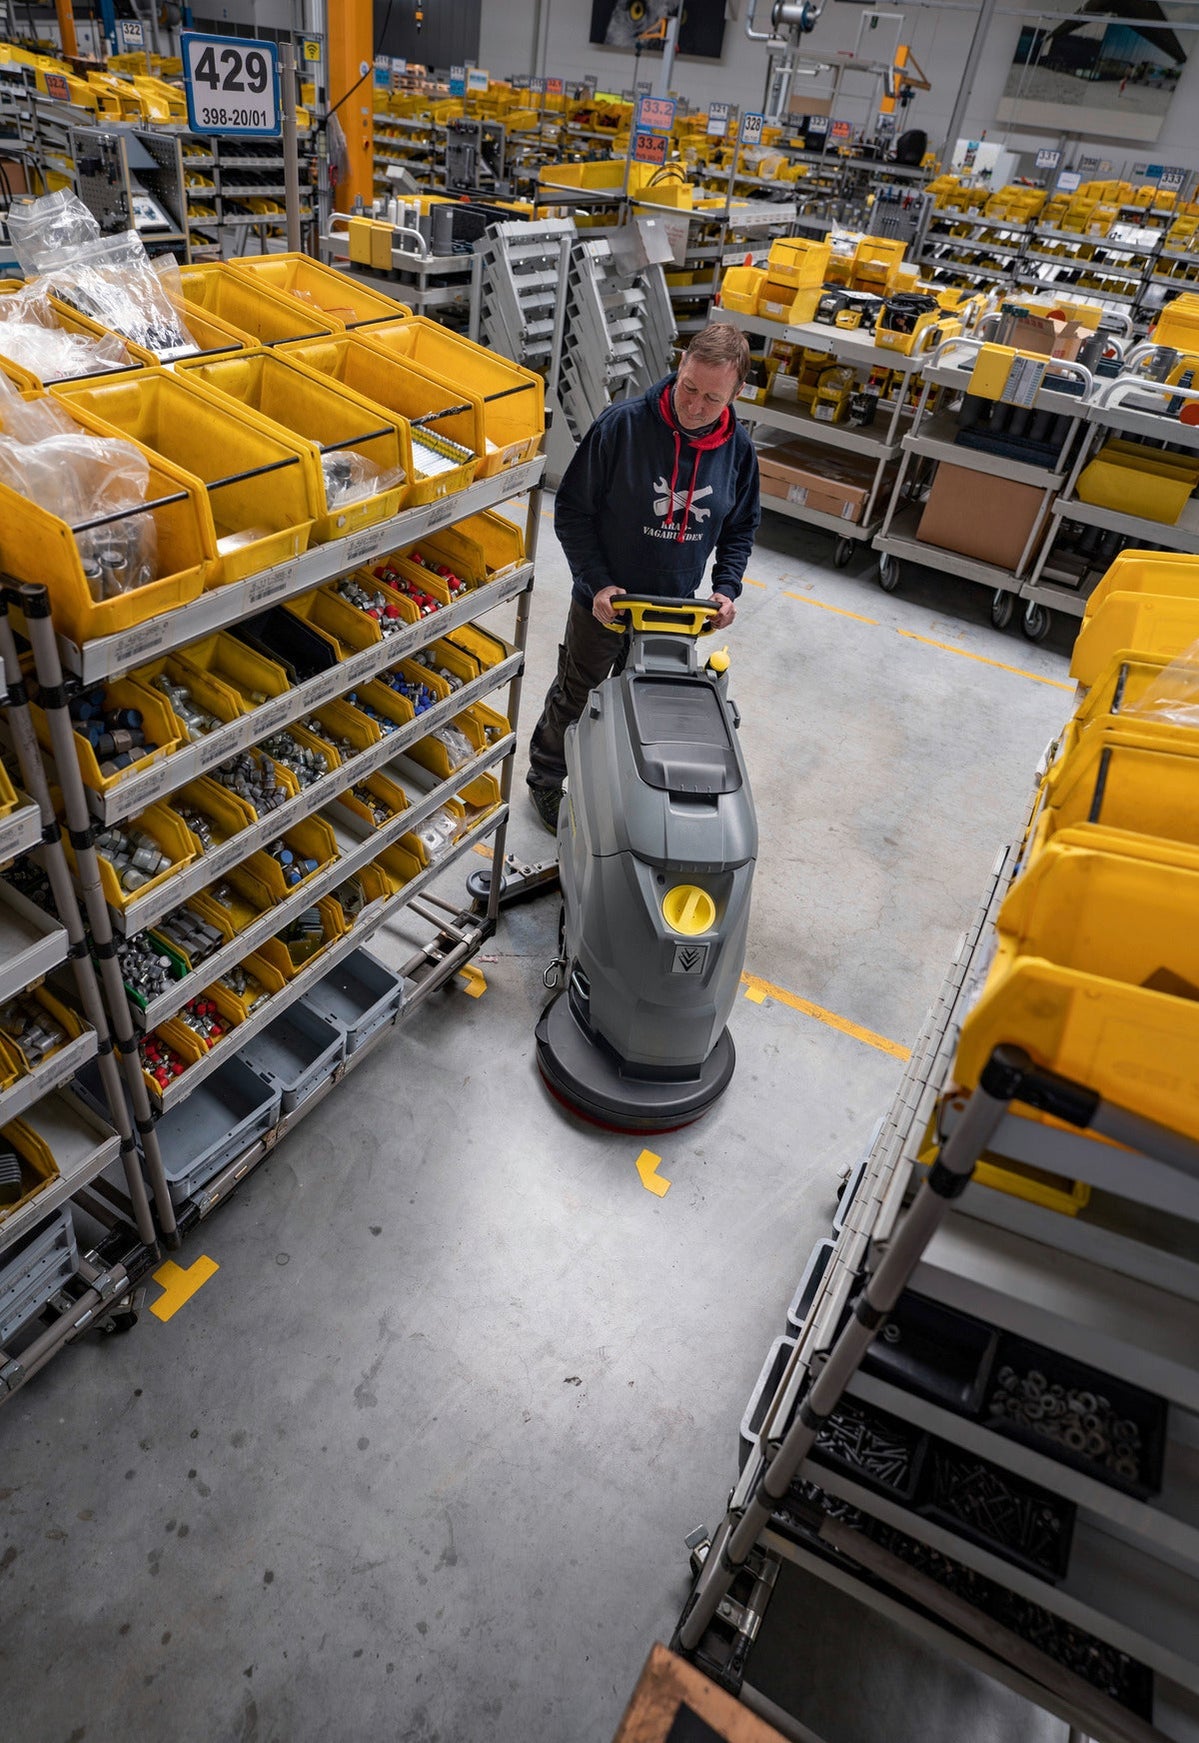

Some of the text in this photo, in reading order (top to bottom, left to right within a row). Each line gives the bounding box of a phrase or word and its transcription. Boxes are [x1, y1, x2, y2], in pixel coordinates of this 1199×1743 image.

[124, 23, 141, 36] 322
[194, 46, 268, 94] 429
[643, 100, 673, 116] 33.2
[202, 107, 267, 127] 398-20/01
[745, 116, 761, 131] 328
[638, 136, 665, 151] 33.4
[661, 520, 691, 531] KRA-
